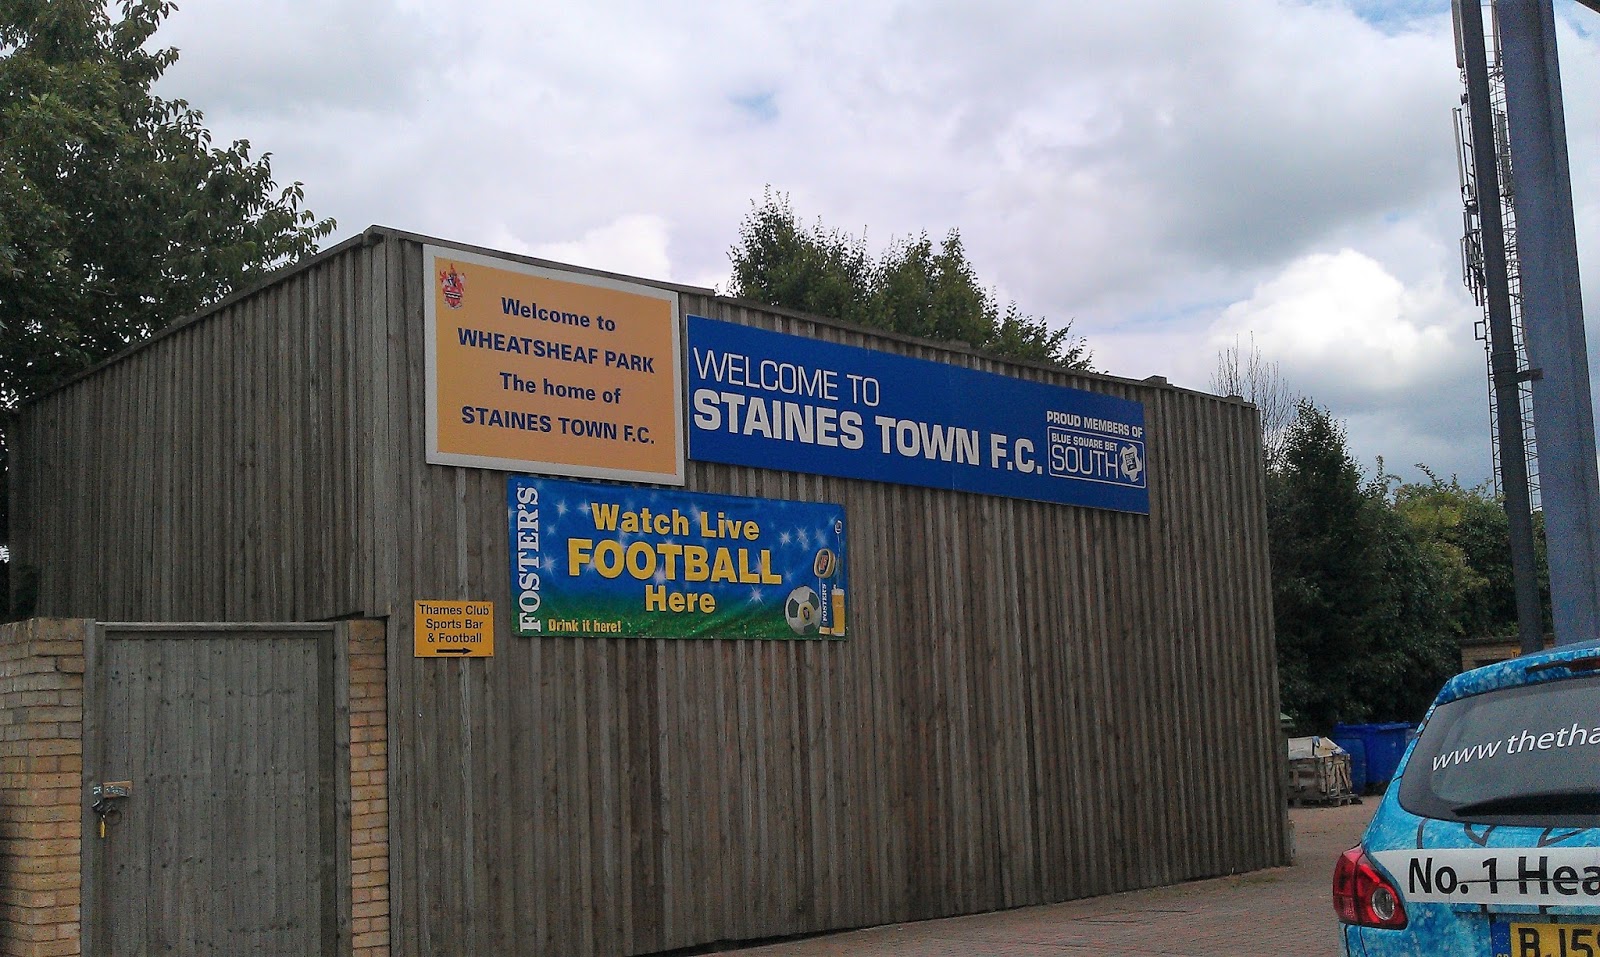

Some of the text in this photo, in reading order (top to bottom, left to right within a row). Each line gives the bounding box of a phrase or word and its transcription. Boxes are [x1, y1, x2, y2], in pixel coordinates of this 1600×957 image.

[501, 297, 616, 332] Welcome to
[457, 327, 655, 374] WHEATSHEAF PARK
[499, 372, 621, 404] The home of
[693, 347, 880, 407] WELCOME TO
[461, 406, 655, 444] STAINES TOWN F.C.
[693, 389, 1043, 474] STAINES TOWN F.C.
[1046, 410, 1143, 438] PROUD MEMBERS OF
[1051, 432, 1118, 452] BLUE SQUARE BET
[1052, 444, 1119, 479] SOUTH
[591, 502, 760, 541] Watch Live
[516, 486, 542, 633] FOSTER'S
[568, 538, 782, 585] FOOTBALL
[419, 604, 489, 616] Thames Club
[645, 585, 716, 613] Here
[425, 618, 484, 631] Sports Bar
[427, 632, 482, 643] & Football
[548, 618, 622, 633] Drink it here!
[1409, 856, 1600, 896] No. 1 Hea
[1518, 927, 1600, 957] BJ5
